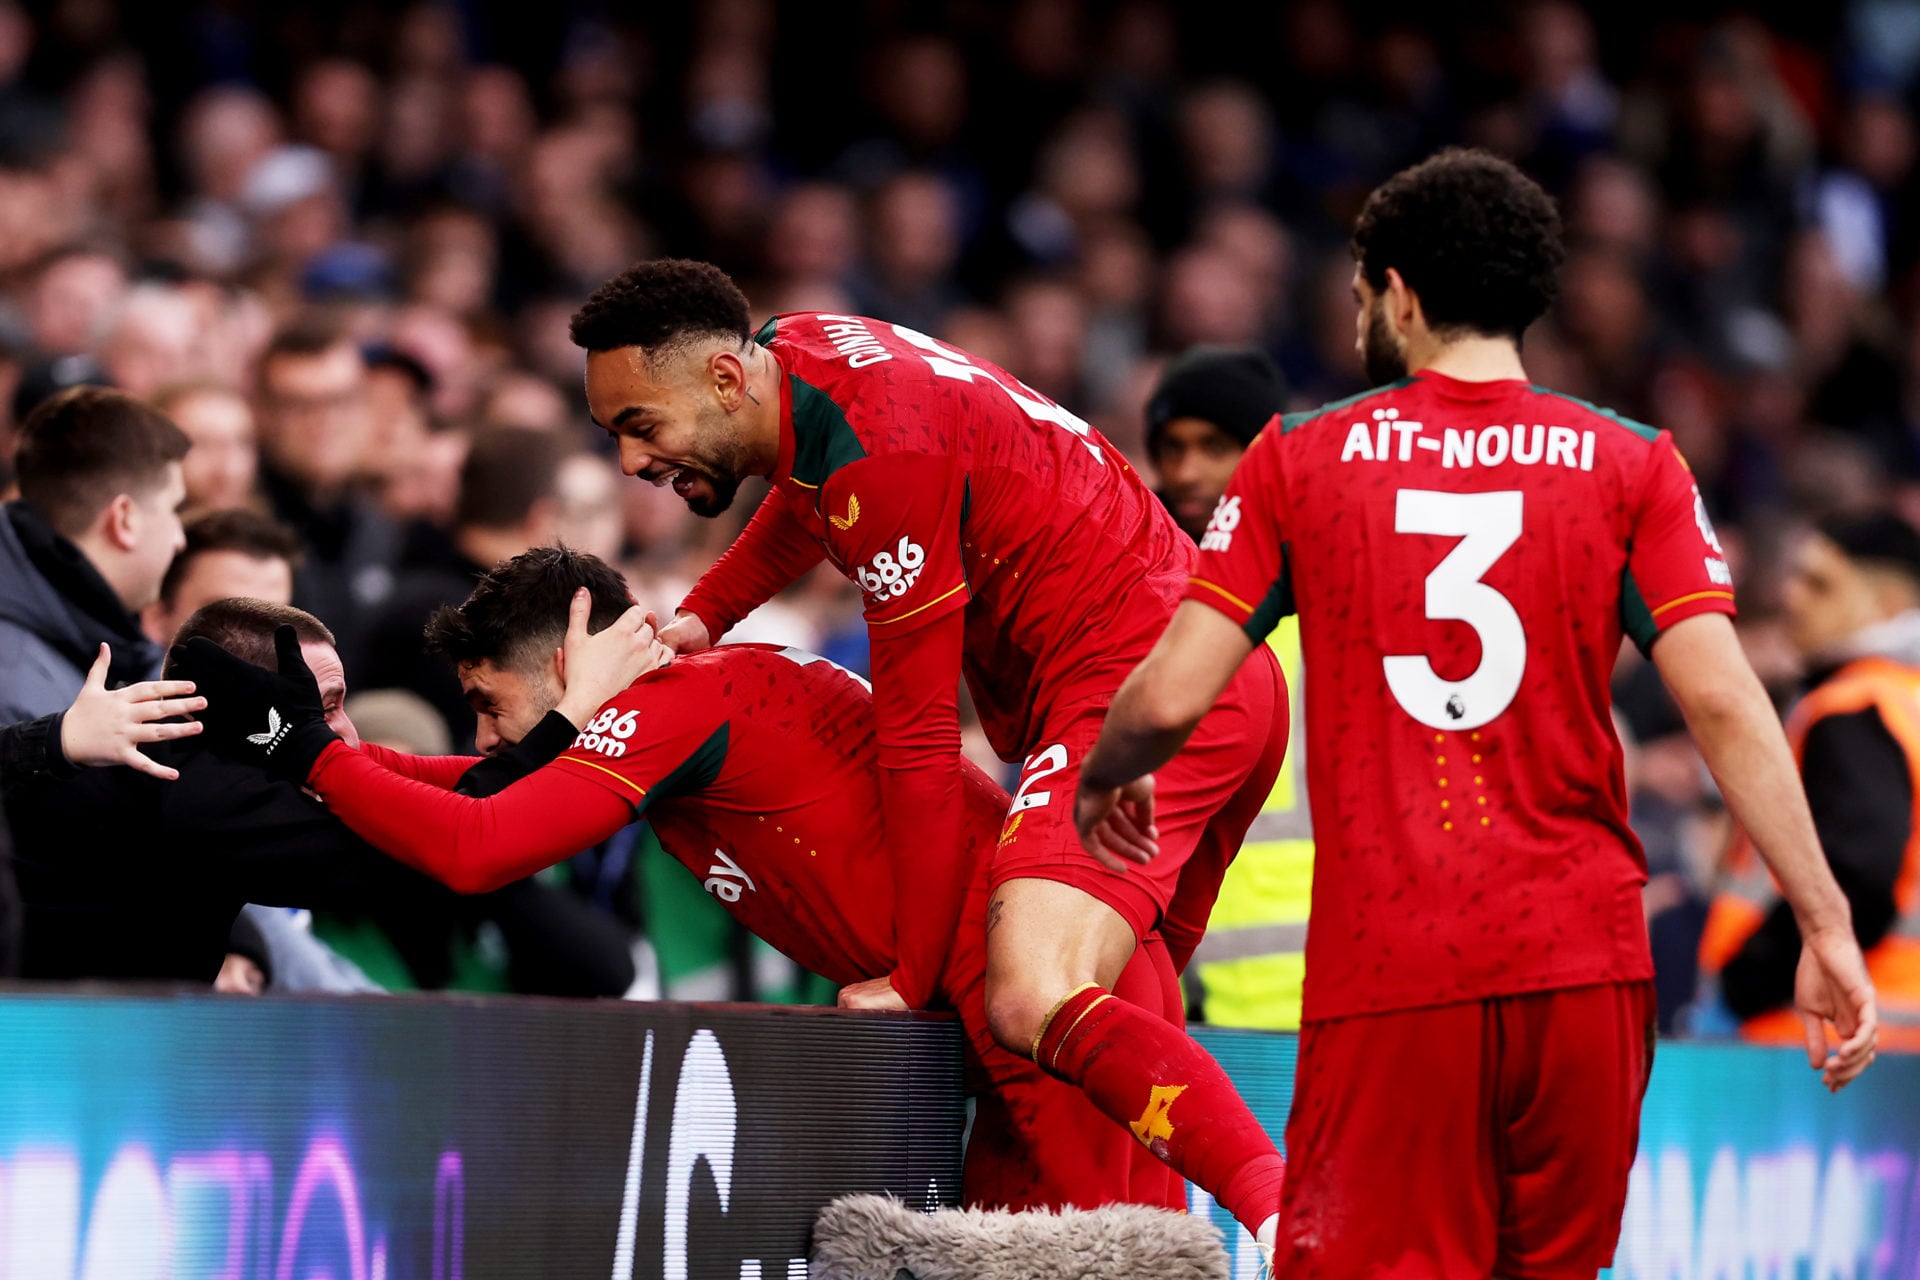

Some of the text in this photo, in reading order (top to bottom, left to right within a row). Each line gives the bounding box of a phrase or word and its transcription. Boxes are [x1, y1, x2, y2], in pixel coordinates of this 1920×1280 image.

[1340, 408, 1596, 472] AÏT-NOURI
[857, 535, 925, 592] 686
[1382, 488, 1528, 731] 3
